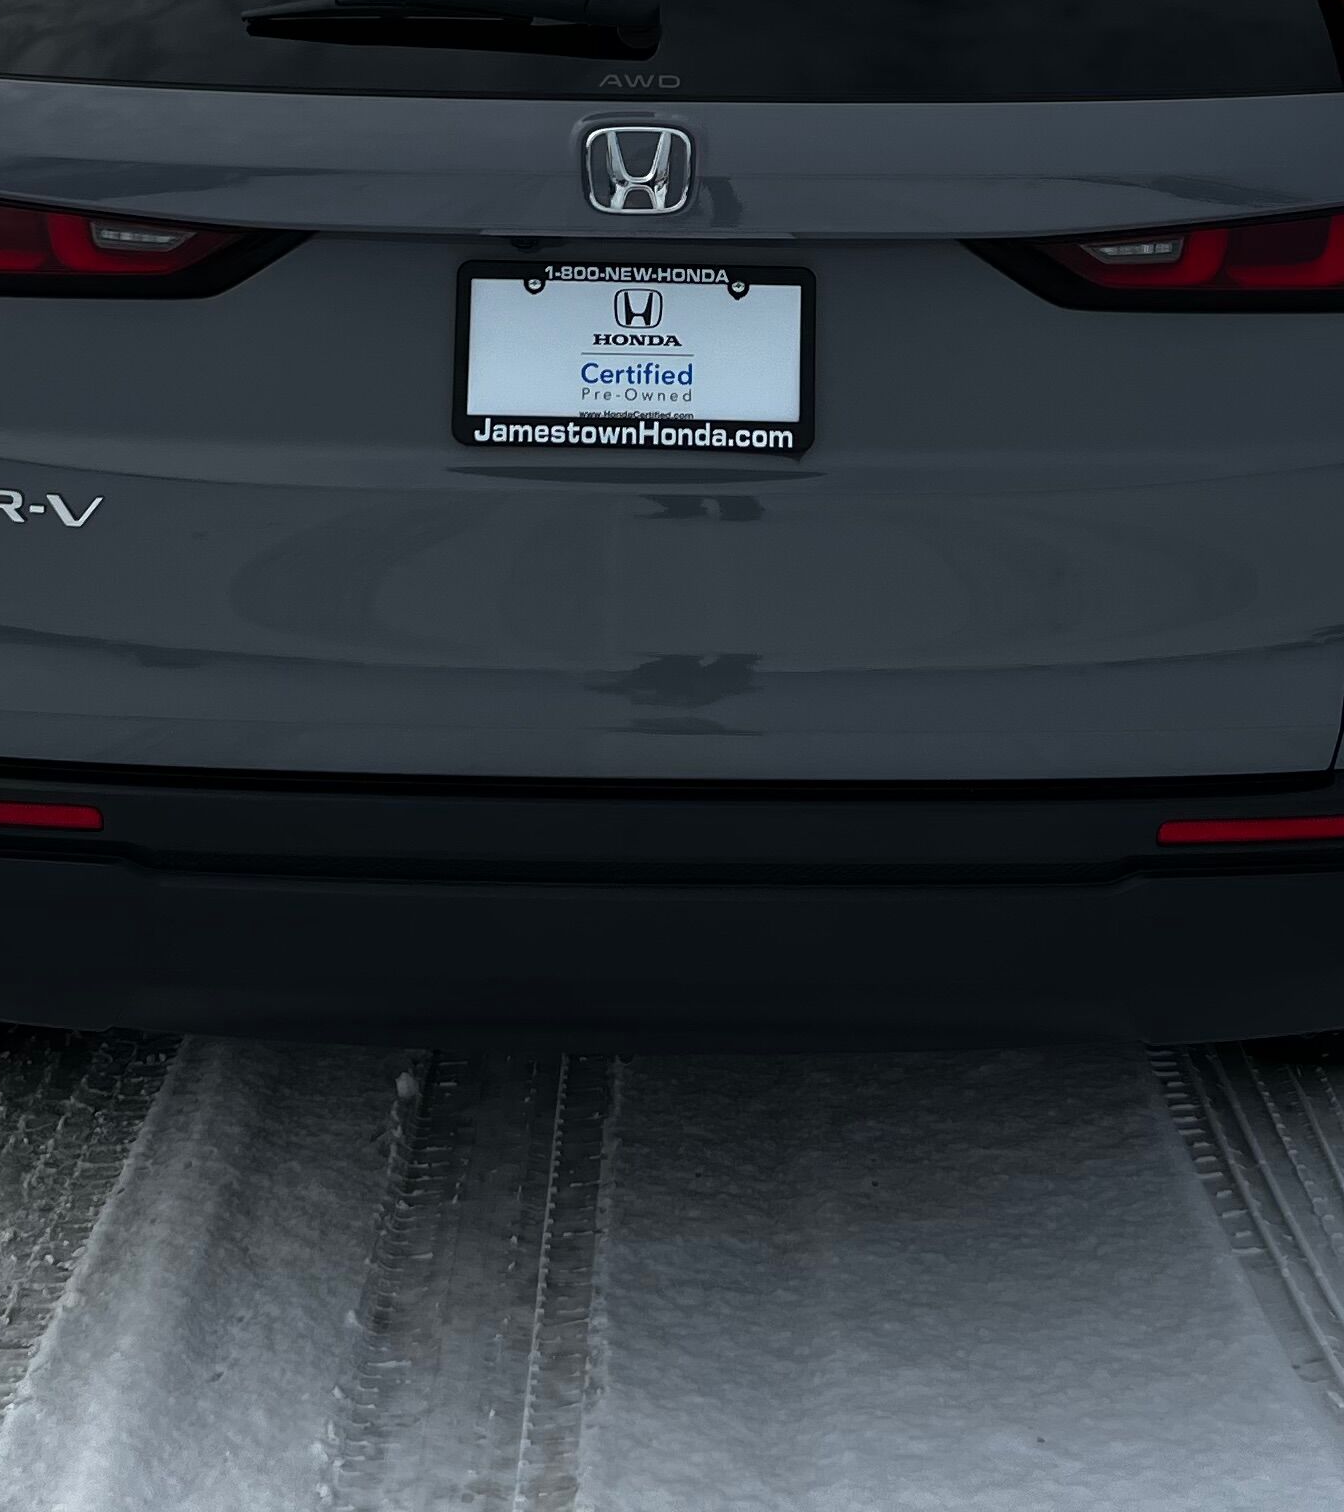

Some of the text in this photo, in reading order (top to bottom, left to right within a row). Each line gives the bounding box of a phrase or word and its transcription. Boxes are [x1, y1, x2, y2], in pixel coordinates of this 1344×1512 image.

[599, 74, 681, 88] AWD
[545, 265, 729, 283] 1-800-NEW-HONDA
[592, 333, 683, 347] HONDA
[581, 363, 693, 385] Certified
[581, 388, 693, 402] Pre-Owned
[474, 417, 793, 448] JamestownHonda.com
